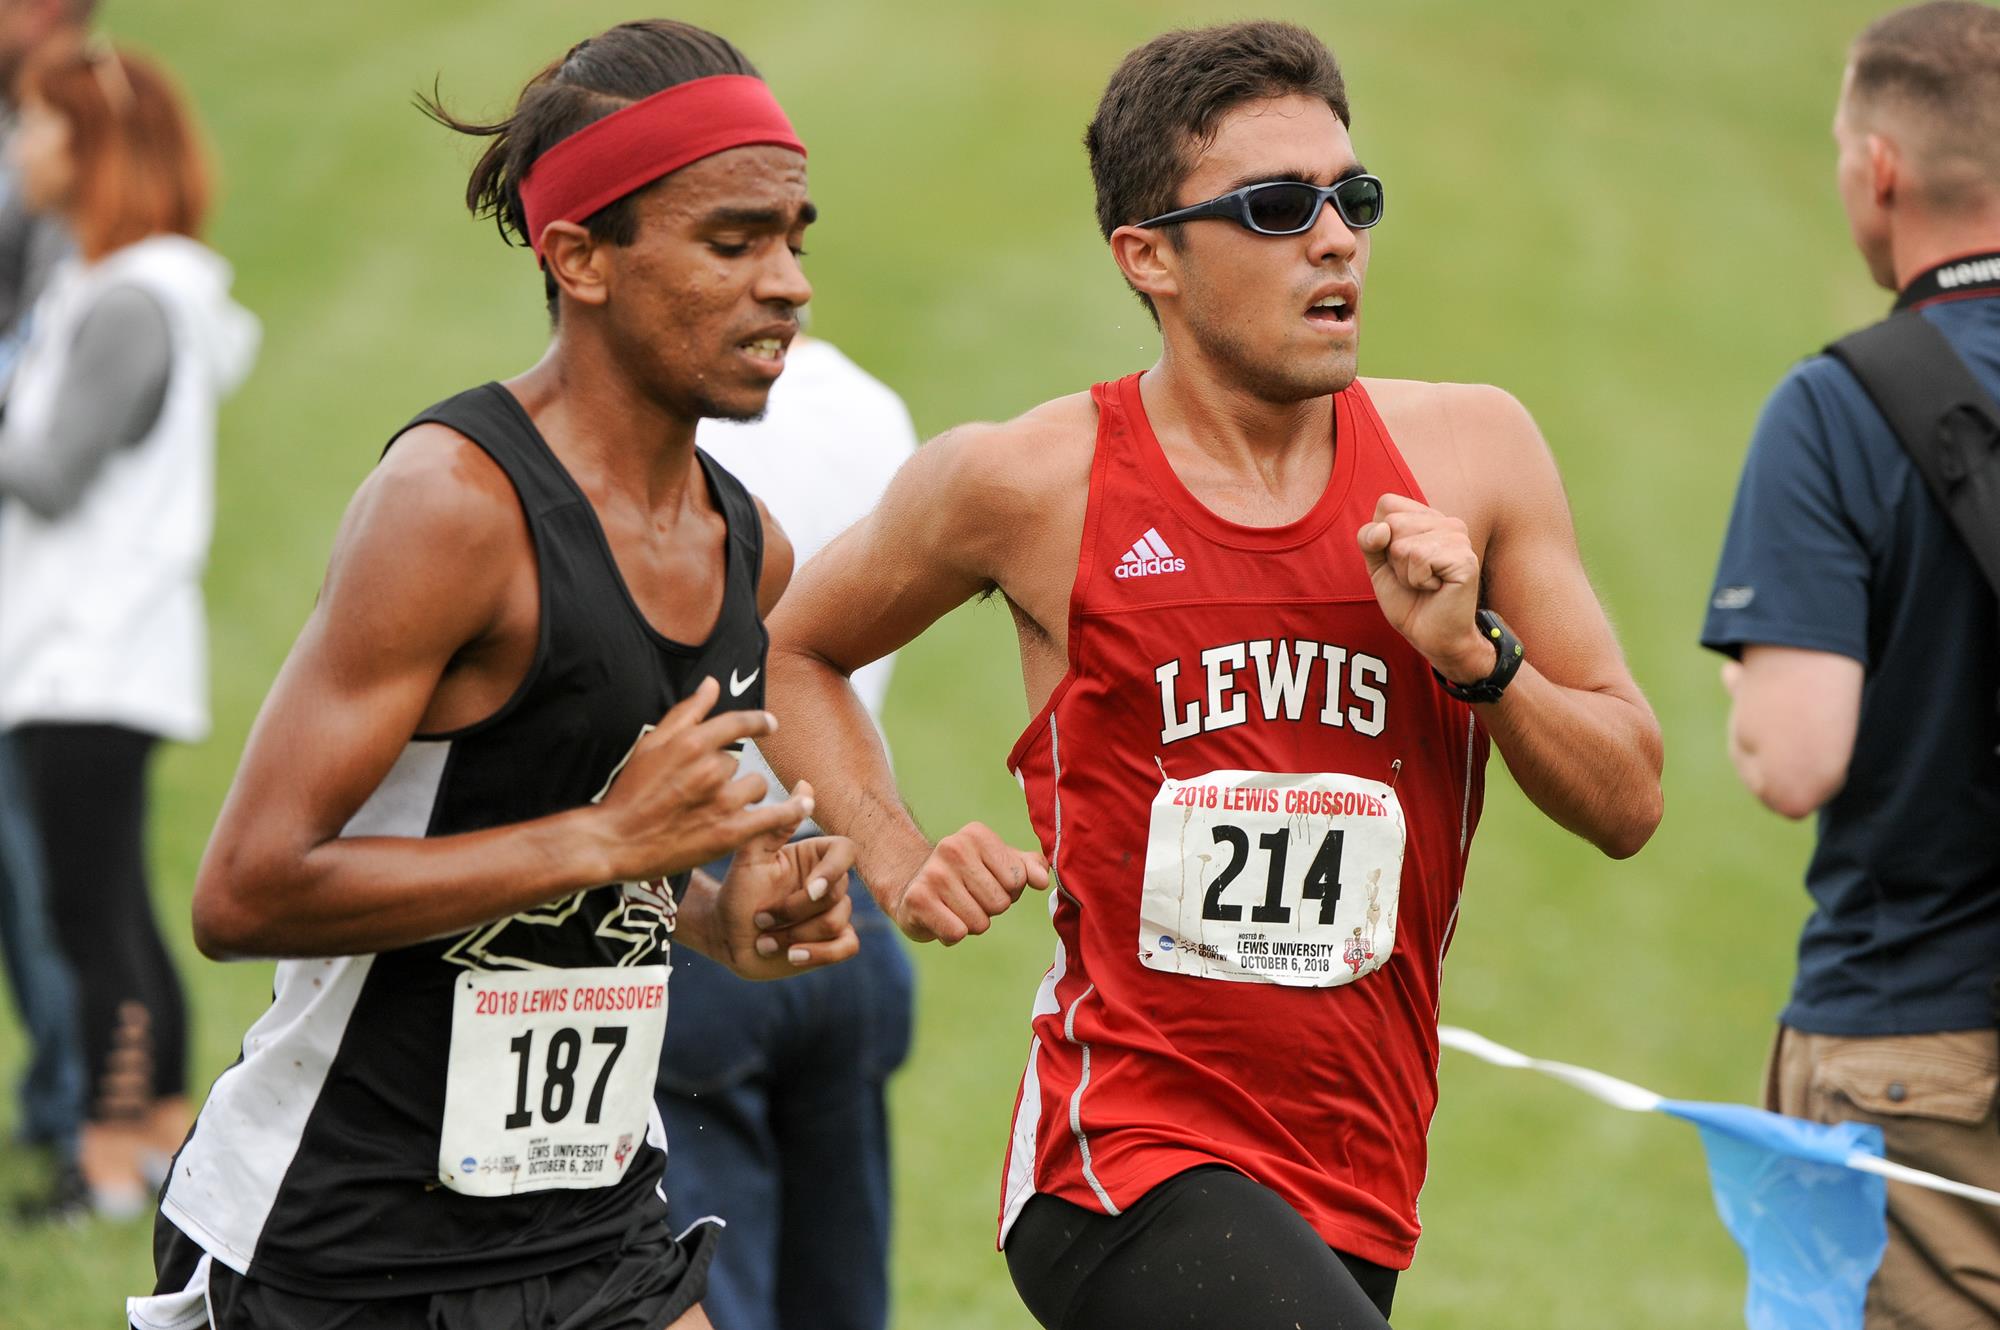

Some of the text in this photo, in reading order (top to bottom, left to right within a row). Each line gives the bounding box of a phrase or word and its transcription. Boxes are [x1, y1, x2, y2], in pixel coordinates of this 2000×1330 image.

[1937, 258, 2000, 288] anon
[1114, 557, 1186, 578] adidas
[1155, 639, 1388, 745] LEWIS
[1173, 785, 1388, 817] 2018 LEWIS CROSSOVER
[1202, 825, 1344, 925] 214
[1198, 943, 1219, 953] CROSS
[1198, 950, 1228, 962] COUNTRY
[1237, 941, 1269, 954] LEWIS
[1272, 942, 1333, 957] UNIVERSITY
[1241, 955, 1288, 970] OCTOBER
[1291, 957, 1301, 974] 6,
[1304, 958, 1330, 972] 2018
[476, 984, 665, 1015] 2018 LEWIS CROSSOVER
[505, 1026, 628, 1130] 187
[528, 1145, 550, 1160] LEWIS
[553, 1144, 608, 1158] UNIVERSITY
[528, 1160, 566, 1175] OCTOBER
[569, 1160, 579, 1175] 6,
[582, 1159, 604, 1173] 2018
